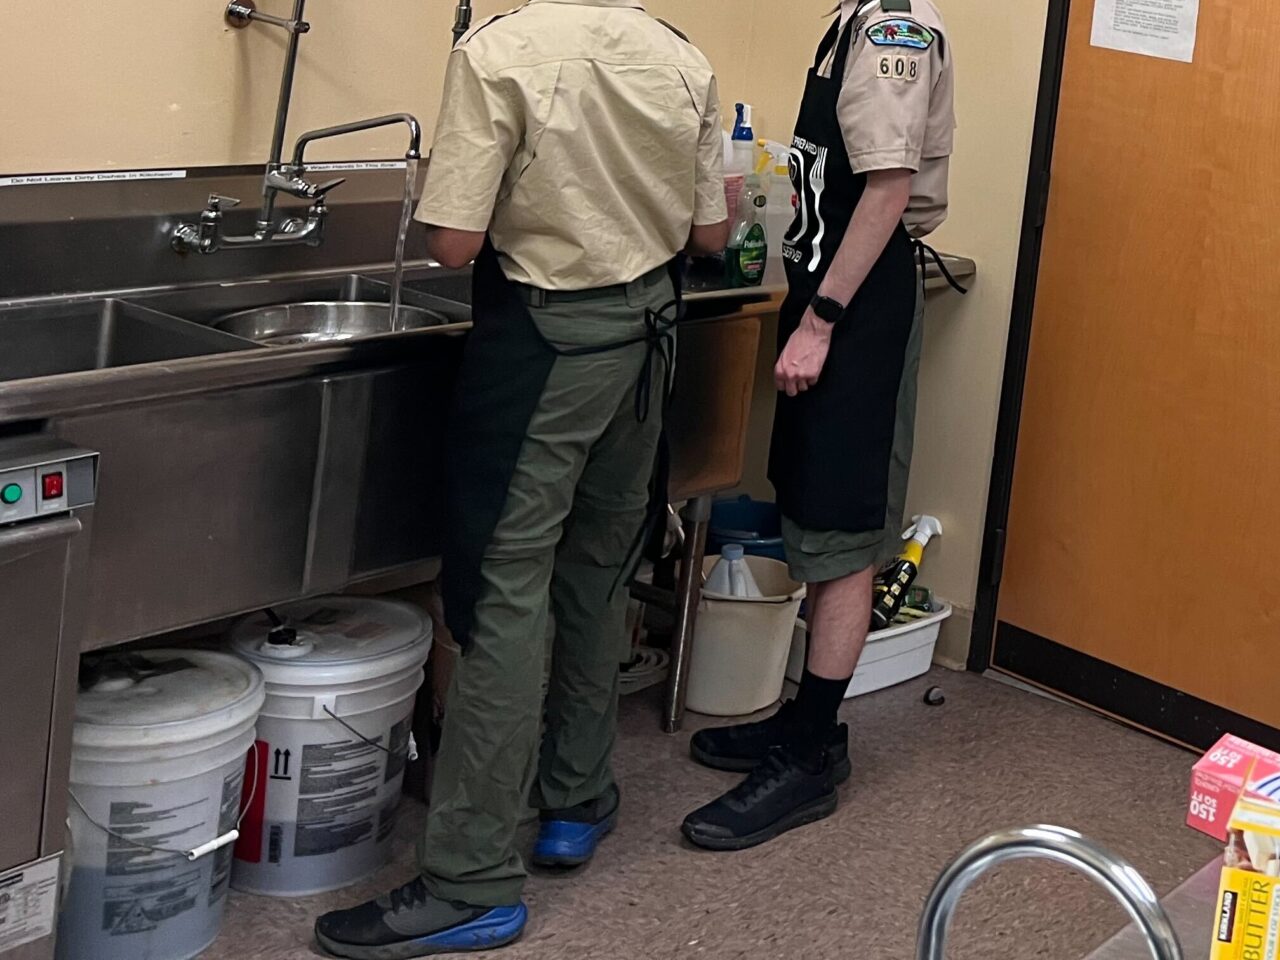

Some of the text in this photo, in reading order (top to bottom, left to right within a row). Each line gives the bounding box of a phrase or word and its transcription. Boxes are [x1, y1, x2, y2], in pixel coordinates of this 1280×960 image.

[880, 58, 916, 78] 608
[1209, 752, 1236, 768] 150
[1192, 790, 1217, 808] SQ FT
[1190, 800, 1217, 822] 150
[1218, 892, 1233, 940] KIRKLAND
[1243, 880, 1270, 960] BUTTER
